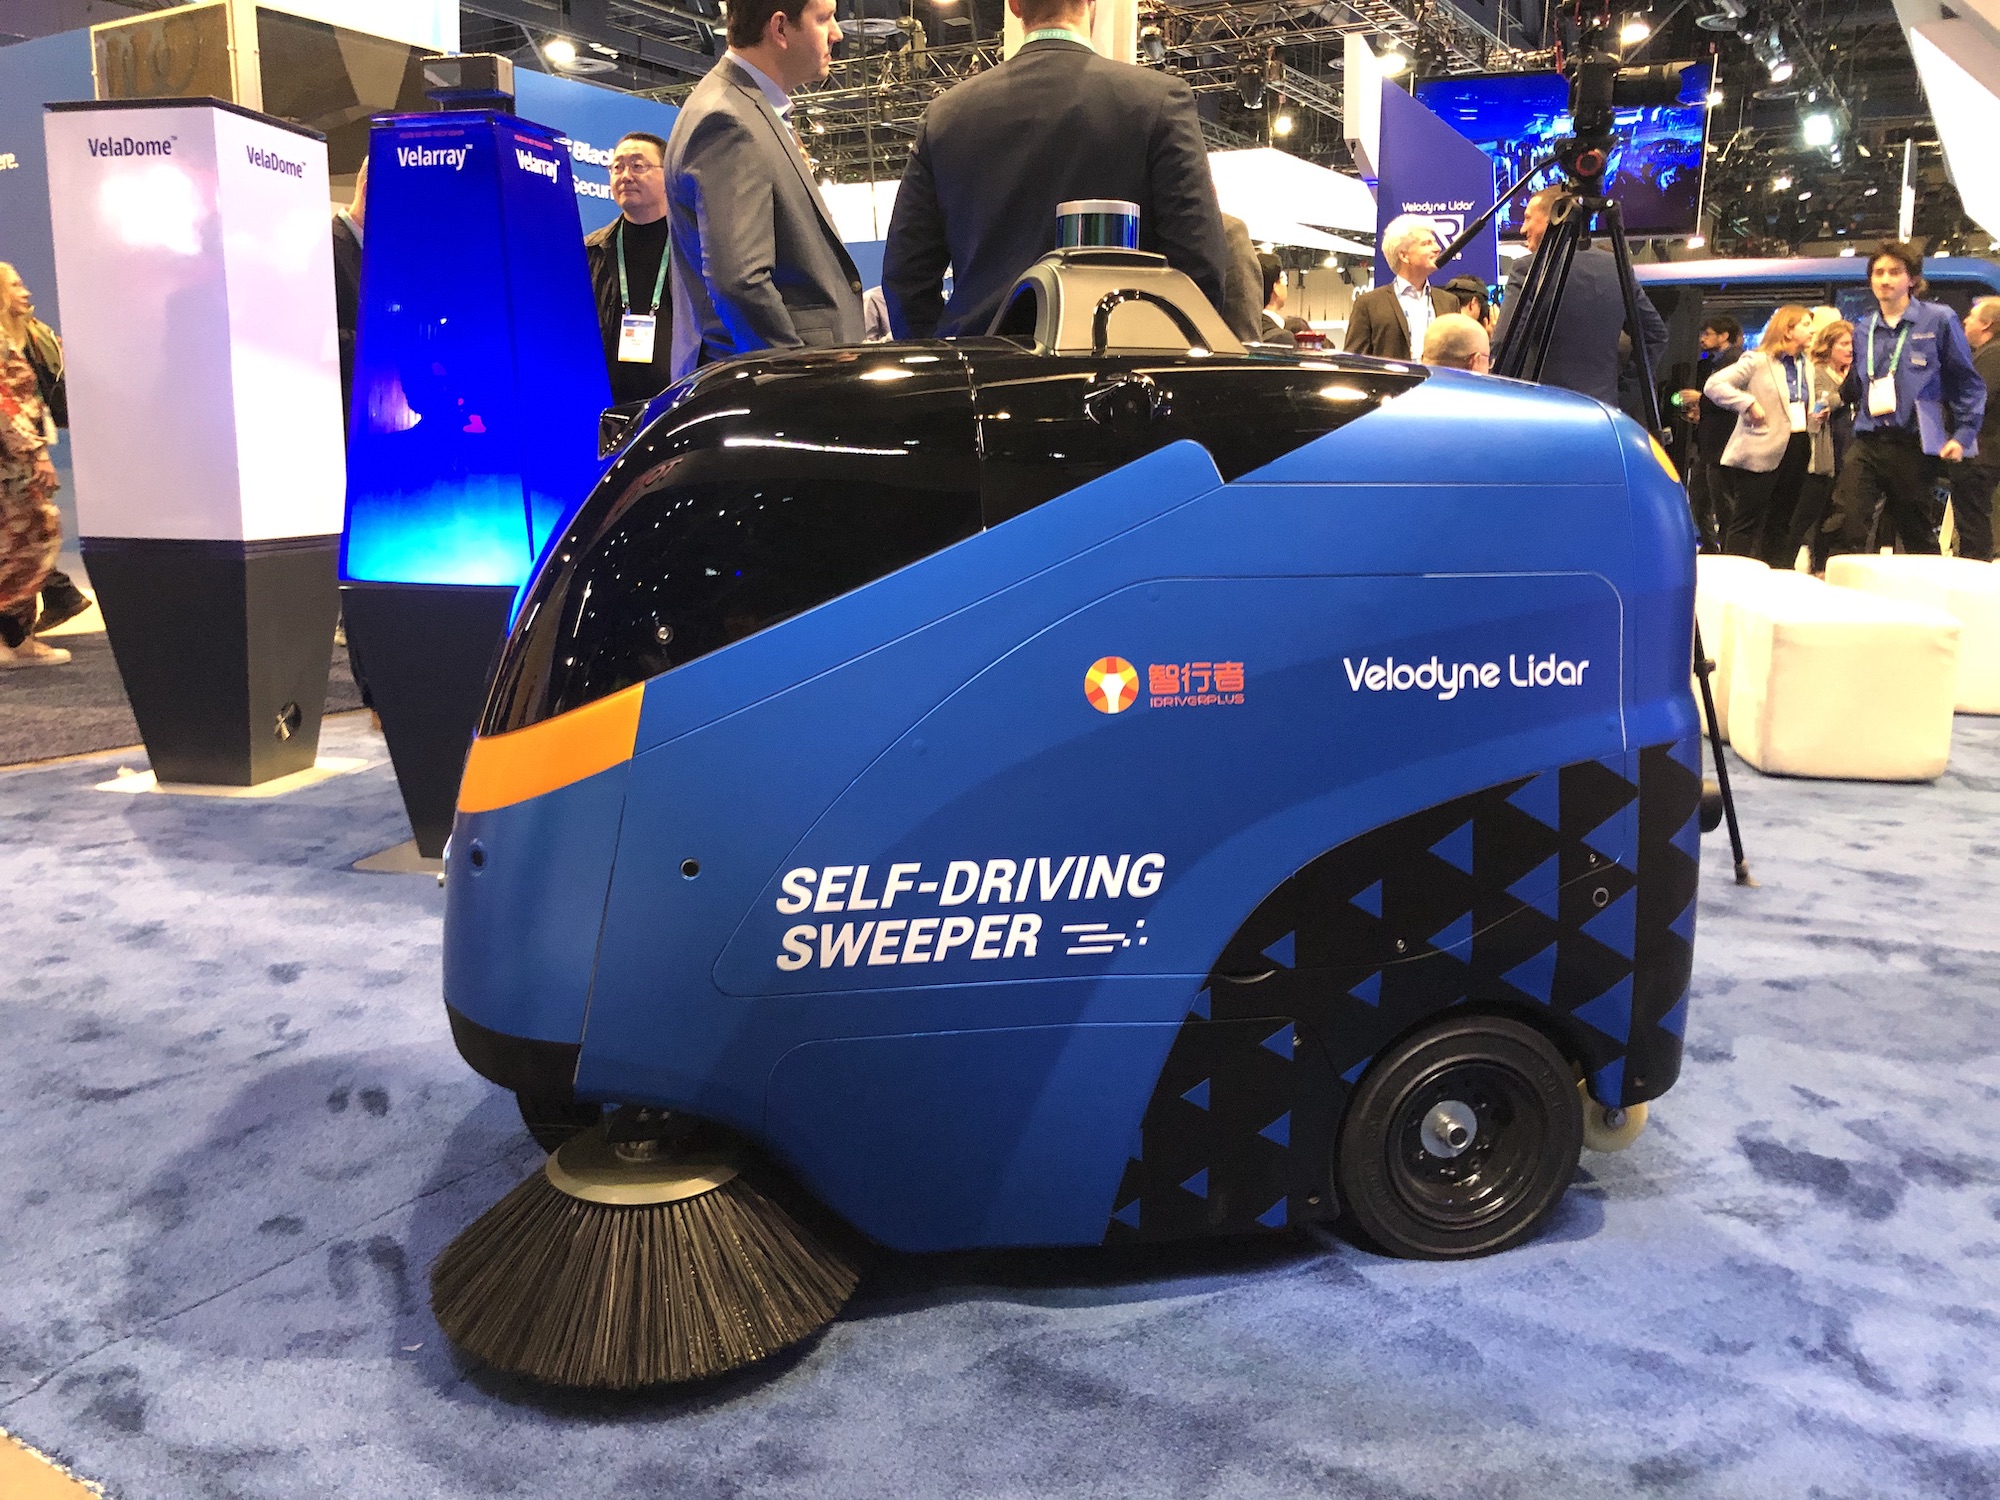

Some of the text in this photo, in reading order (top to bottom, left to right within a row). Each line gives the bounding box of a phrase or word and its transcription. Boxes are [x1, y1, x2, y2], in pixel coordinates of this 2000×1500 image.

[1401, 201, 1475, 214] Velodyne Lidar
[1148, 661, 1244, 694] 智行者
[1343, 653, 1590, 700] Velodyne Lidar
[1150, 694, 1245, 708] IDRIVERPLUS
[776, 853, 1165, 915] SELF-DRIVING
[776, 913, 1043, 971] SWEEPER
